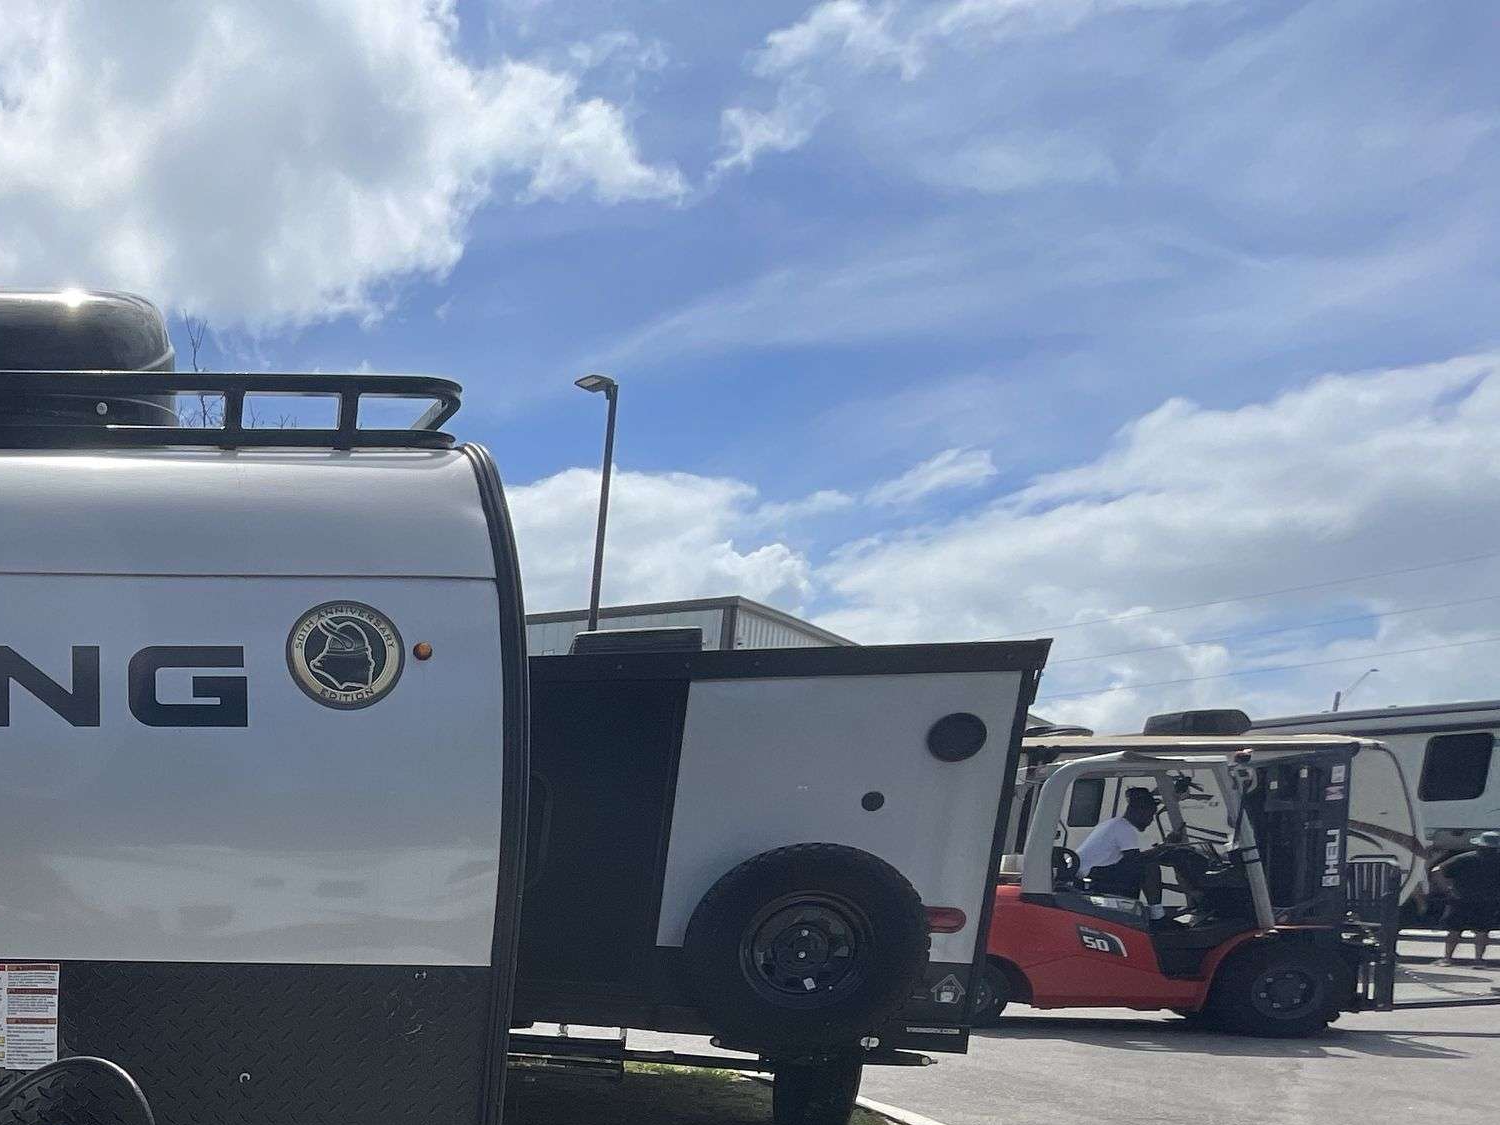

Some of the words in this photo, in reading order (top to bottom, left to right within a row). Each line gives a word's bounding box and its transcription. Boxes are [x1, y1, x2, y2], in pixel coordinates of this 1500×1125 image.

[295, 619, 315, 649] 50TH
[317, 606, 395, 649] ANNIVERSARY
[320, 687, 374, 701] EDITION
[1082, 935, 1110, 951] 50
